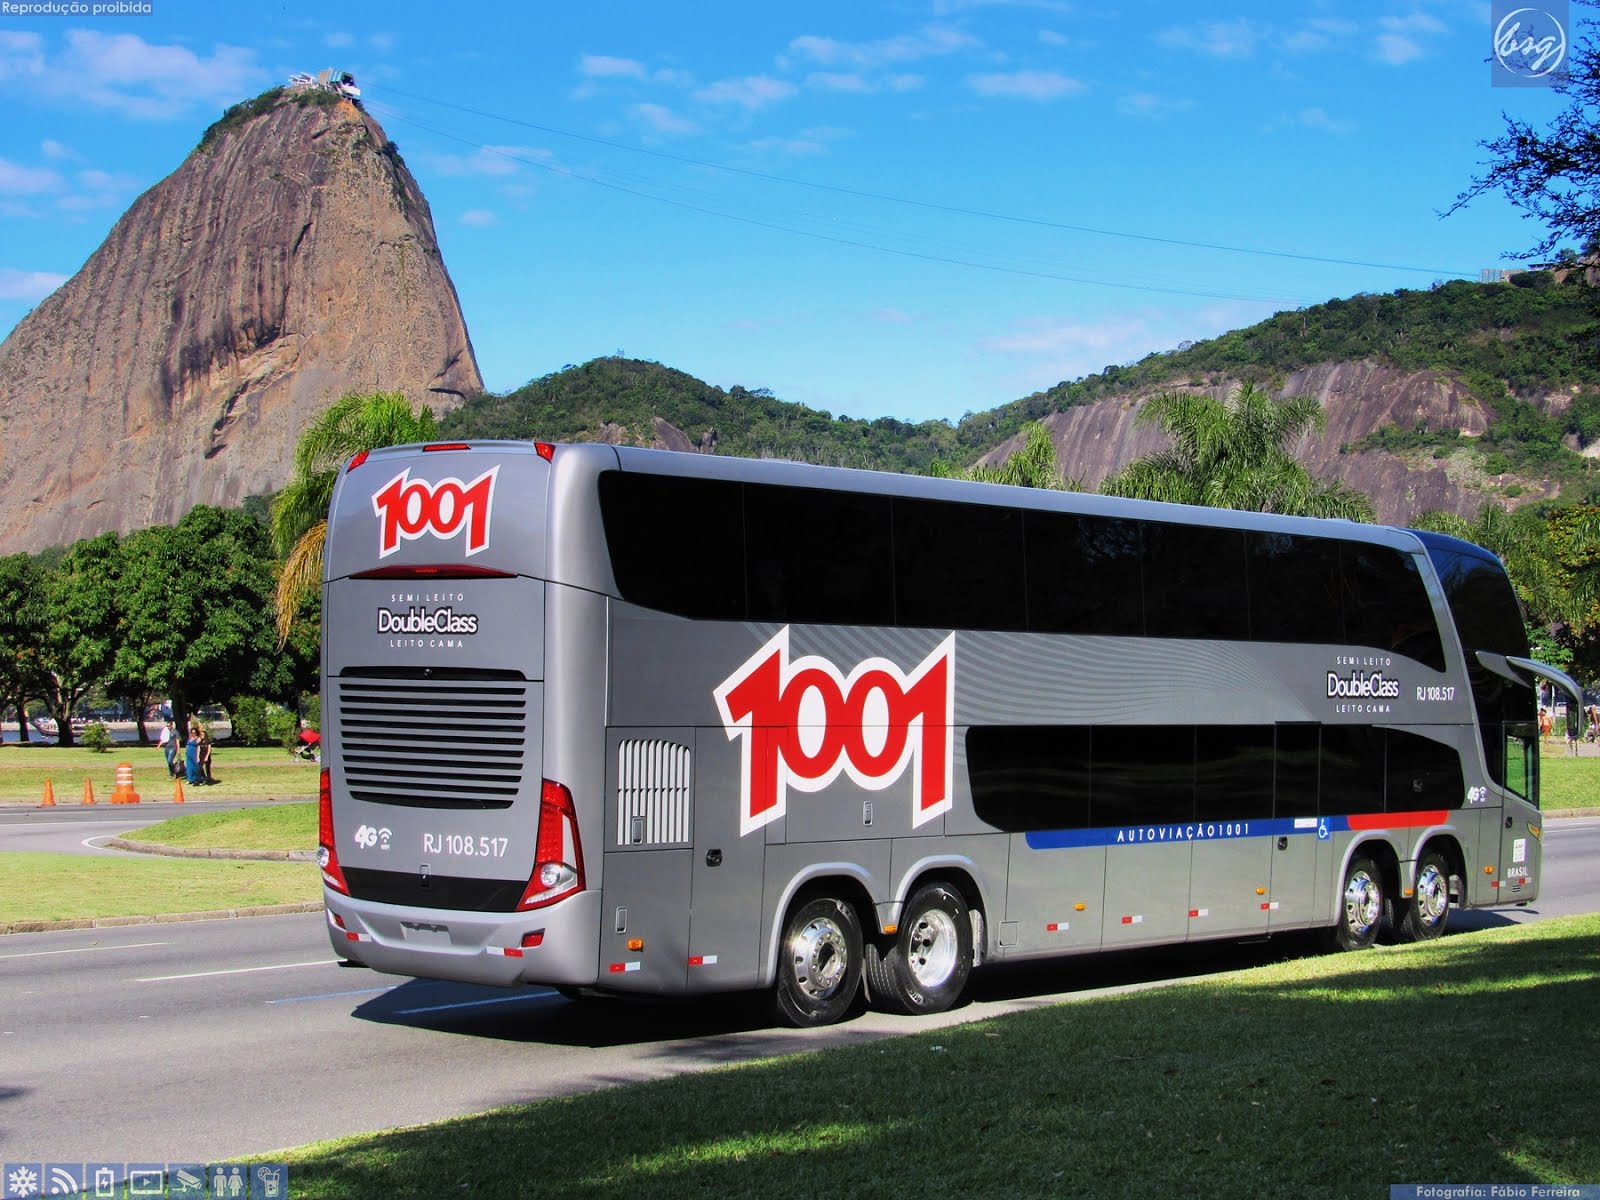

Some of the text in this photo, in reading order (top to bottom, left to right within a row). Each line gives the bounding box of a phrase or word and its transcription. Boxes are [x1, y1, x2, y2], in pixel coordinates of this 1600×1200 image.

[371, 464, 500, 559] 1001
[391, 593, 464, 603] SEMI LEITO
[377, 606, 479, 634] DoubleClass
[390, 639, 463, 648] LEITO CAMA
[1336, 656, 1391, 666] SEMI LEITO
[1327, 670, 1400, 698] DoubleClass
[1416, 686, 1426, 701] RJ
[1336, 704, 1390, 713] LEITO CAMA
[713, 624, 956, 837] 1001
[354, 824, 378, 849] 4G
[423, 833, 509, 858] RJ 108.517
[1507, 866, 1528, 878] BRASIL
